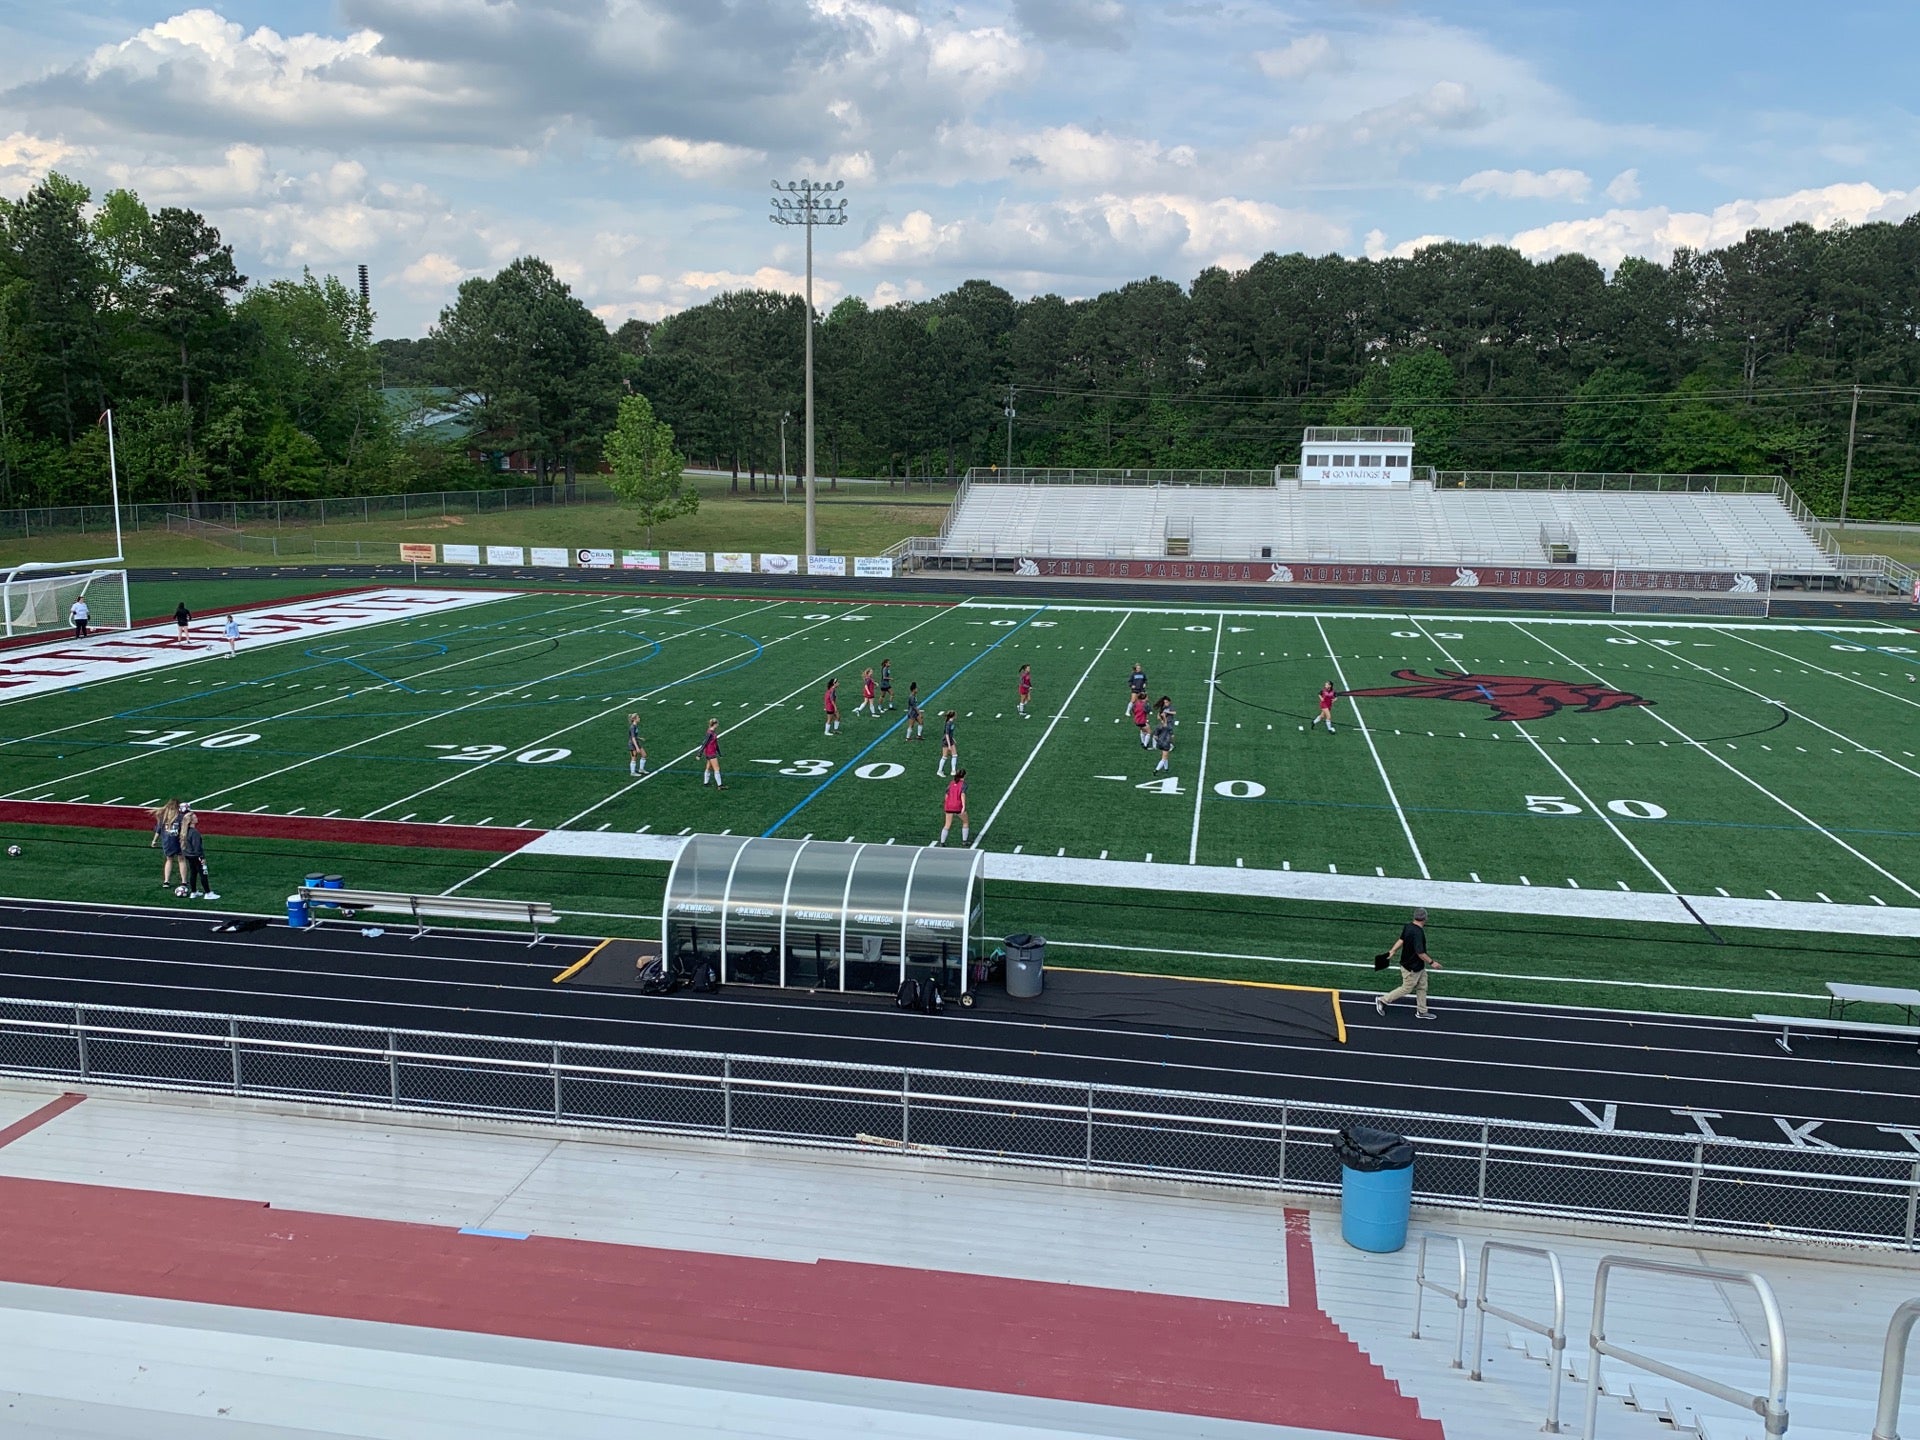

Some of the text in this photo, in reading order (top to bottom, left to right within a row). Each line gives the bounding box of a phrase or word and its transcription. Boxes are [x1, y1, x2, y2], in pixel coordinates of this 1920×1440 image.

[1333, 470, 1344, 479] GO
[809, 556, 844, 565] BARFIELD
[1048, 561, 1719, 590] THIS IS VALHALLA NORTHGATE THIS IS VALHALLA
[881, 1138, 919, 1151] NORTATE
